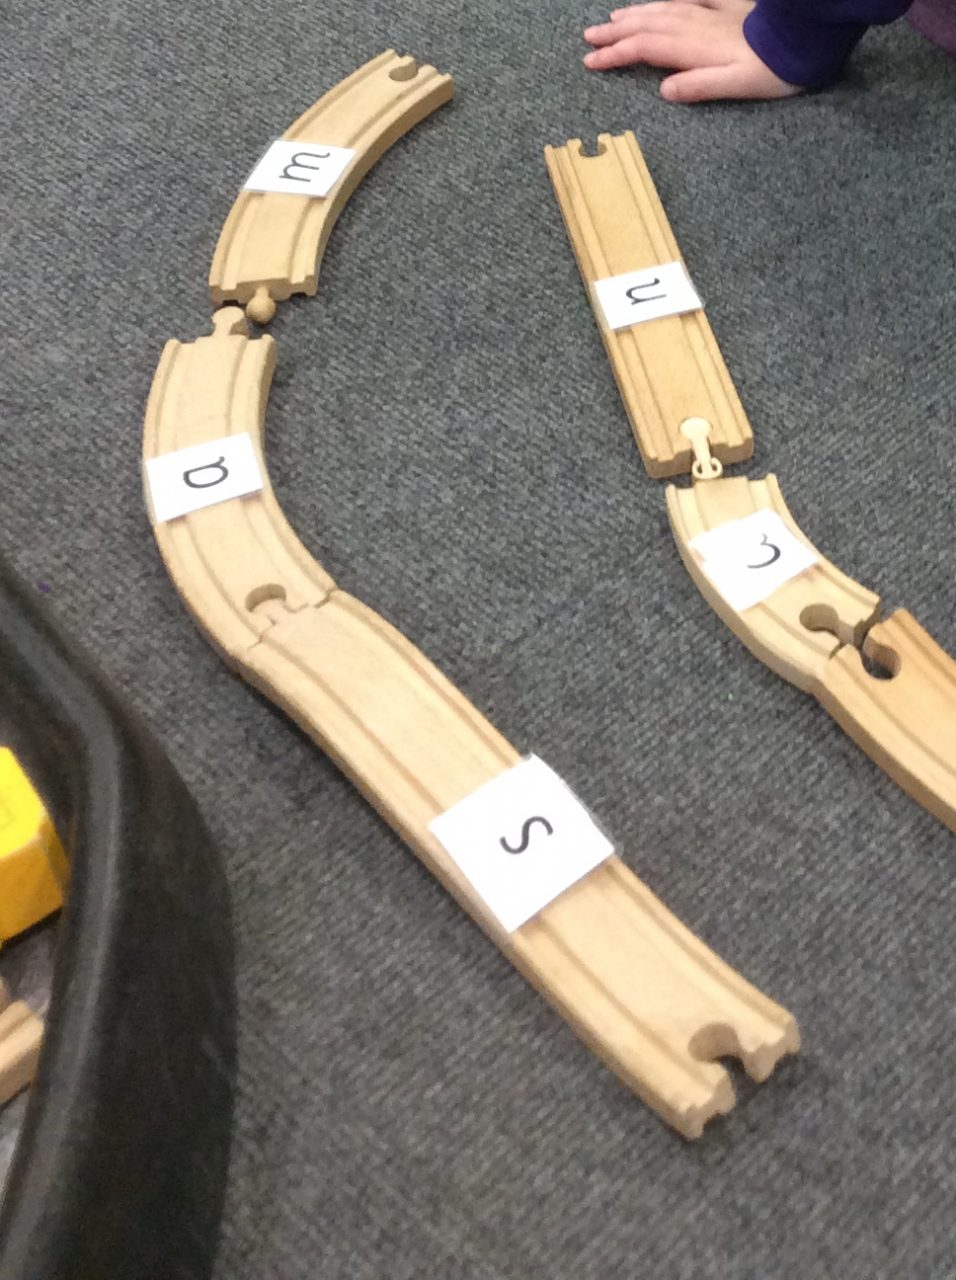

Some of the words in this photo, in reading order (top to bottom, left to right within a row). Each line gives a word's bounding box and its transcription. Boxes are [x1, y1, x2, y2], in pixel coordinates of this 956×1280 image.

[278, 151, 331, 183] m
[183, 456, 229, 489] a
[499, 815, 554, 855] s
